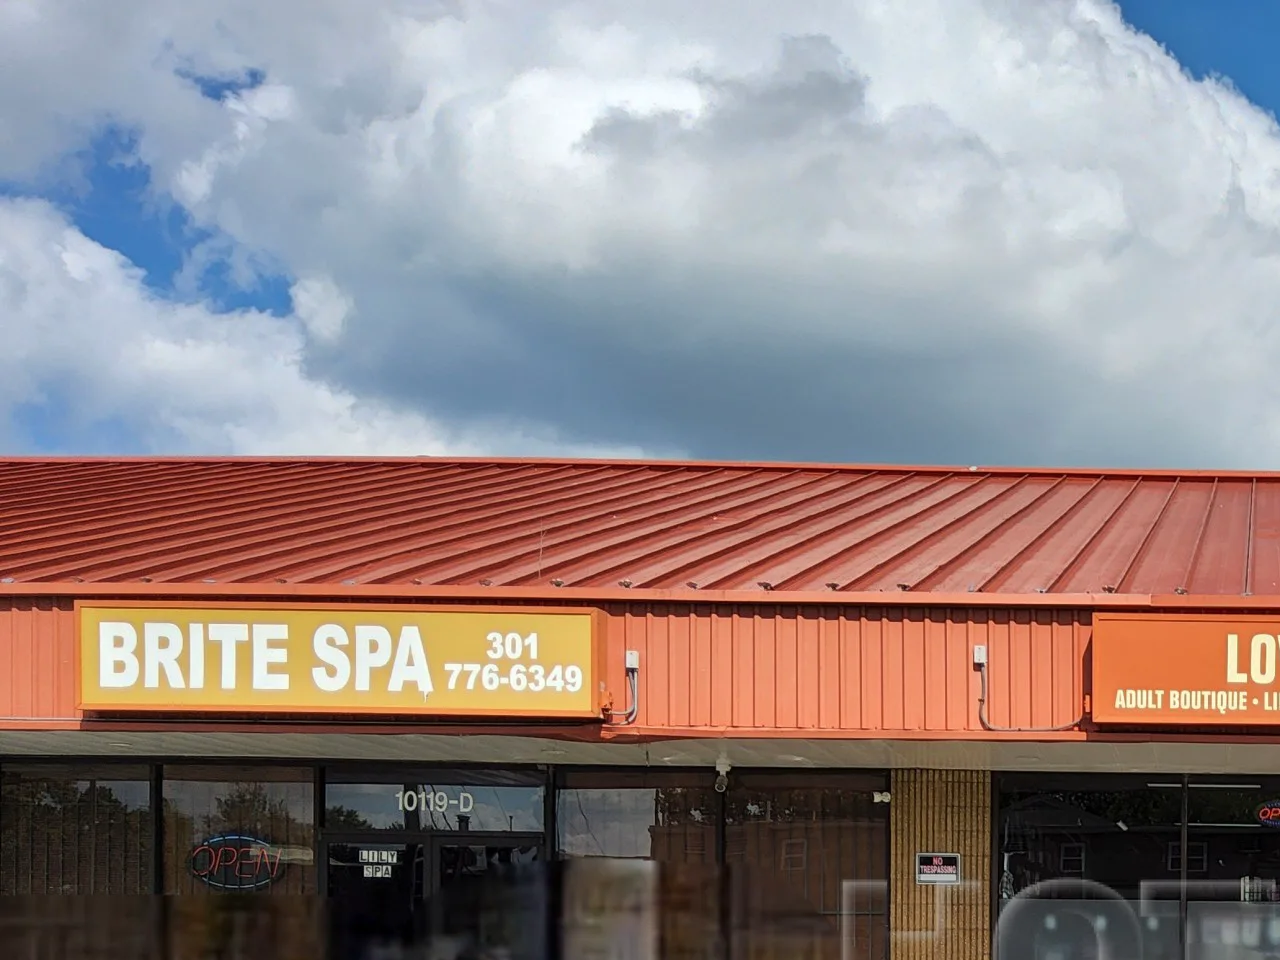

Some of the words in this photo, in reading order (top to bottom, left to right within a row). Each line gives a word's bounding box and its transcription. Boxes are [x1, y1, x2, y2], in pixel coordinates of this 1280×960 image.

[98, 621, 290, 690] BRITE
[311, 624, 434, 693] SPA
[486, 632, 538, 659] 301
[443, 663, 584, 692] 776-6349
[1114, 688, 1165, 709] ADULT
[1169, 690, 1248, 715] BOUTIQUE
[395, 790, 474, 813] 10119-D
[191, 845, 283, 878] OPEN
[359, 850, 398, 863] LILY
[932, 856, 944, 865] NO
[363, 865, 392, 878] SPA
[920, 865, 957, 874] TRESPASSING
